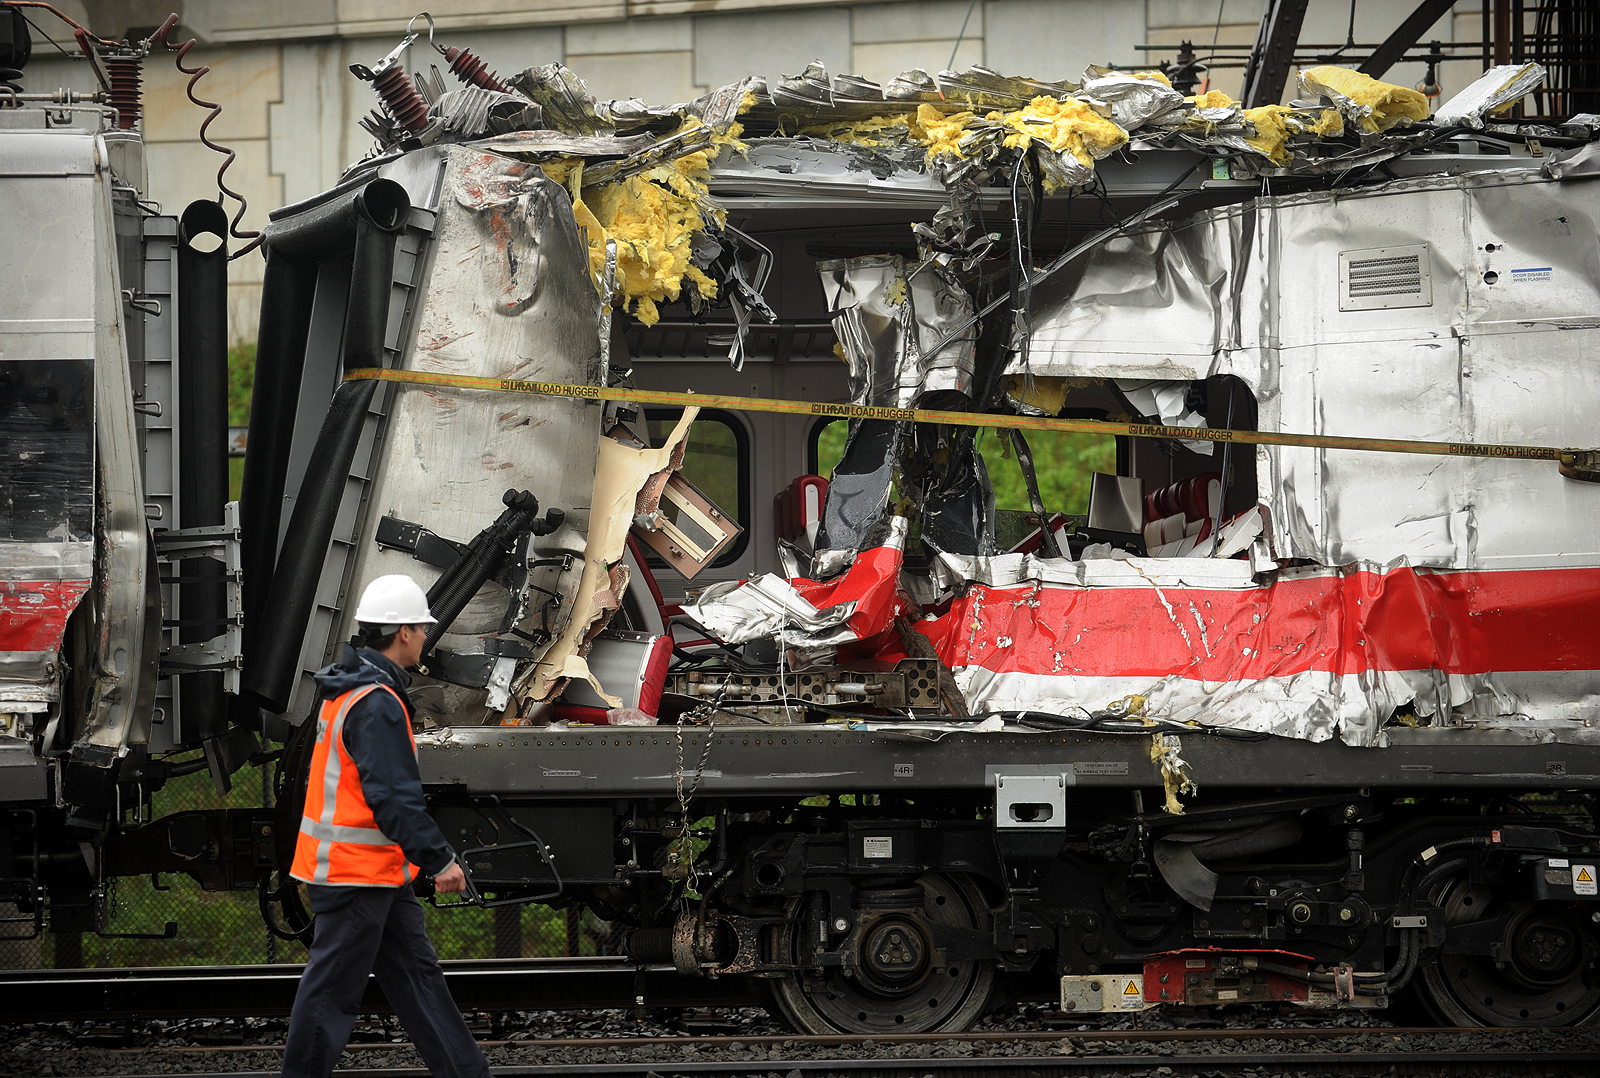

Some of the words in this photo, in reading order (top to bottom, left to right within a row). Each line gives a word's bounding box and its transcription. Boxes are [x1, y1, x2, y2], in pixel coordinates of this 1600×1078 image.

[538, 384, 560, 394] LOAD
[563, 386, 599, 398] HUGGER
[852, 407, 875, 417] LOAD
[877, 409, 915, 420] HUGGER
[1169, 428, 1193, 438] LOAD
[1195, 430, 1233, 440] HUGGER
[1490, 447, 1514, 457] LOAD
[1517, 449, 1555, 458] HUGGER
[898, 766, 910, 774] 4R
